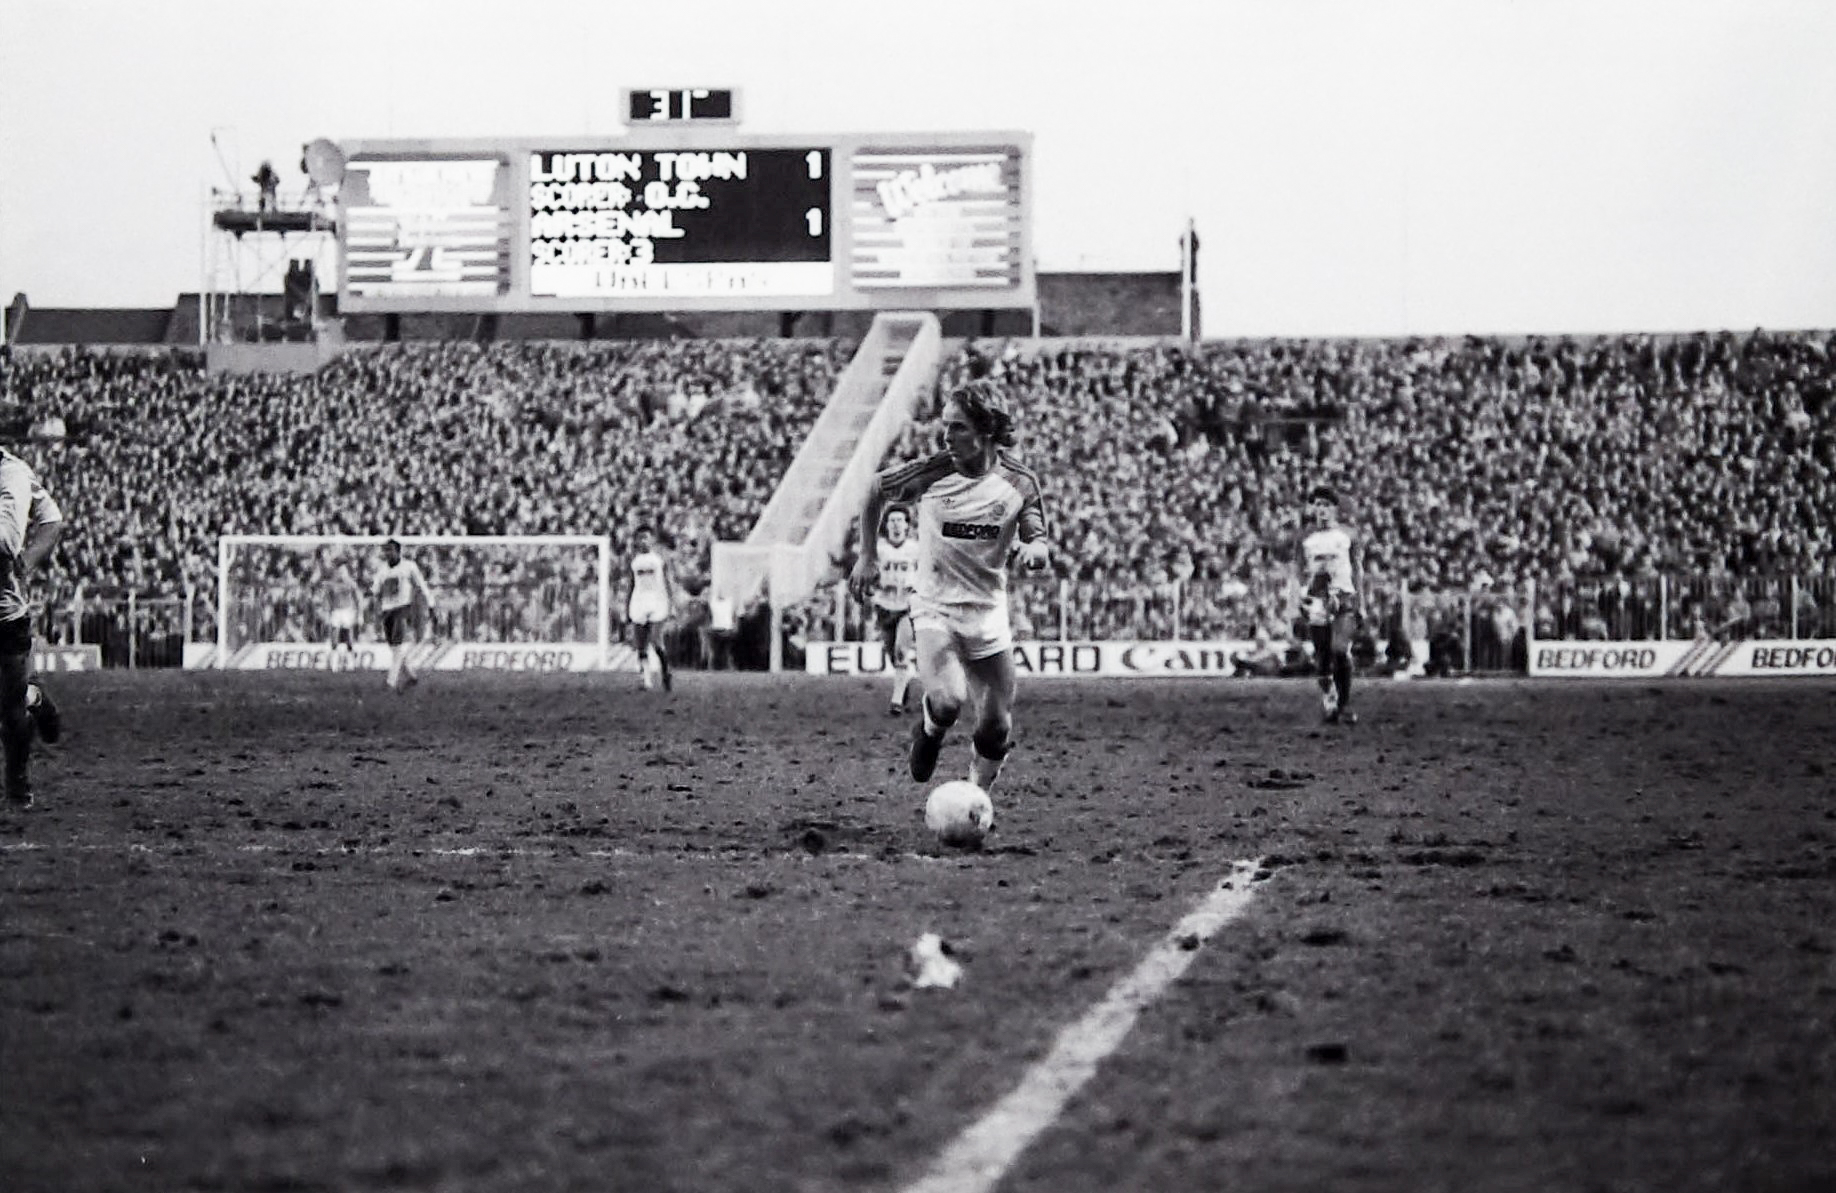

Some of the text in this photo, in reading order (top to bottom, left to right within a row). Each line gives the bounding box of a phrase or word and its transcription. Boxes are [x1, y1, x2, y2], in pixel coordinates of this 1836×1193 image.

[530, 150, 823, 182] LUTON TOWN 1
[530, 207, 823, 238] ARSENAL 1
[463, 650, 573, 671] BEDFORD
[1537, 649, 1657, 669] BEDFORD
[1751, 647, 1836, 668] BEDFO
